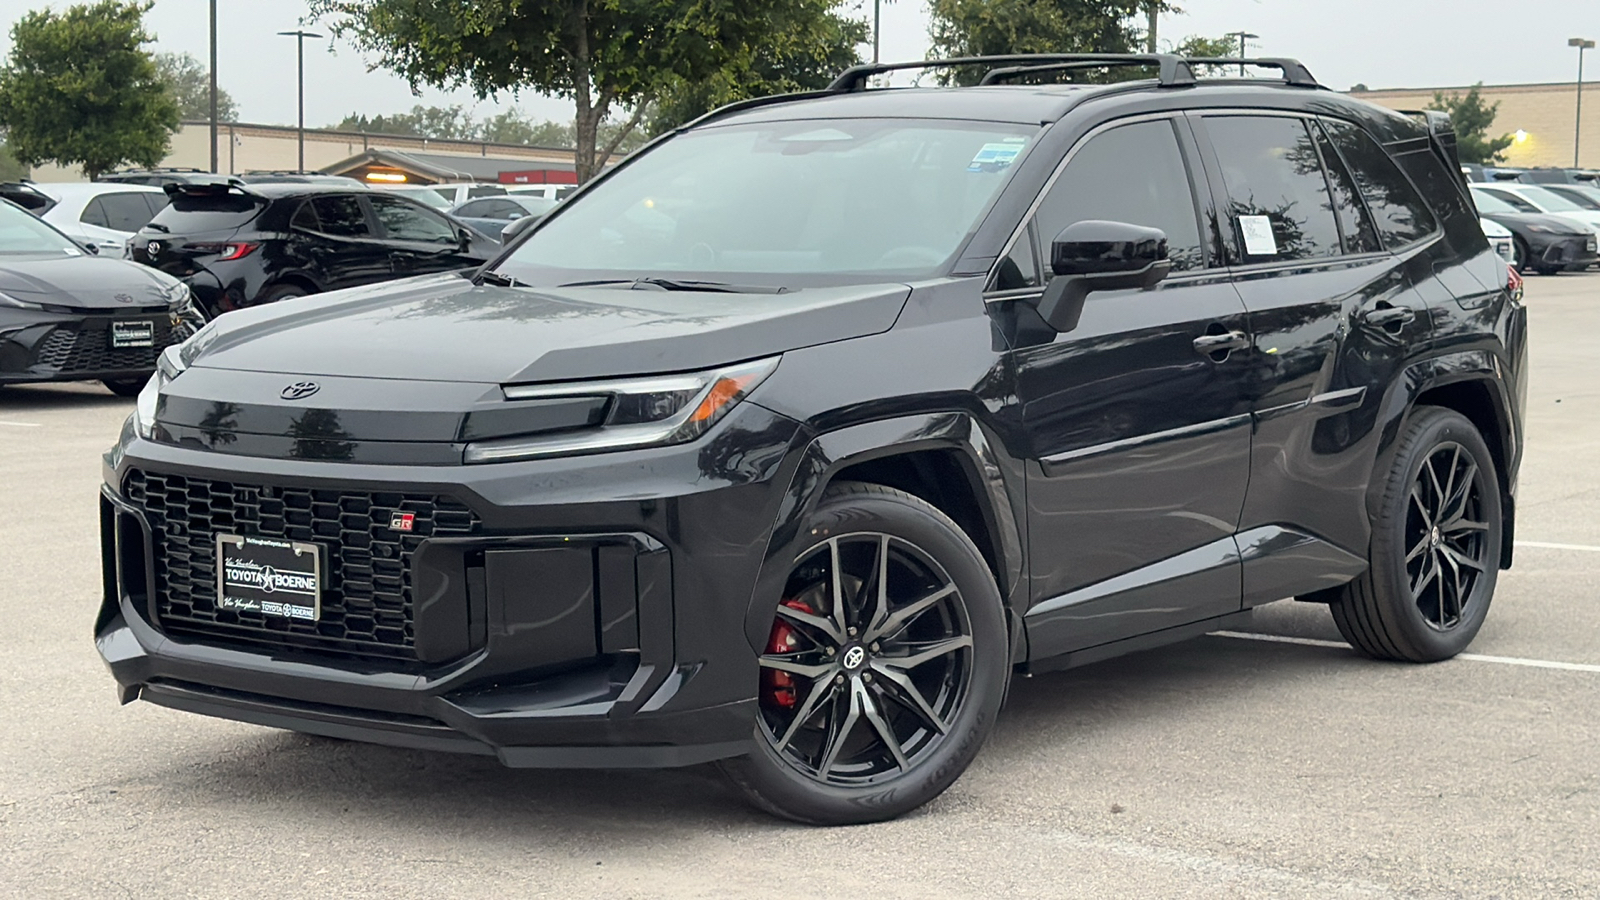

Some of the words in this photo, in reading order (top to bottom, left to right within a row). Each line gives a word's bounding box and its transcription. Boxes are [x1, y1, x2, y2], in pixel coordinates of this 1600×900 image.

[392, 518, 412, 529] GR
[225, 569, 263, 583] TOYOTA
[275, 575, 316, 590] BOERNE
[262, 604, 283, 613] TOYOTA
[292, 608, 314, 616] BOERNE
